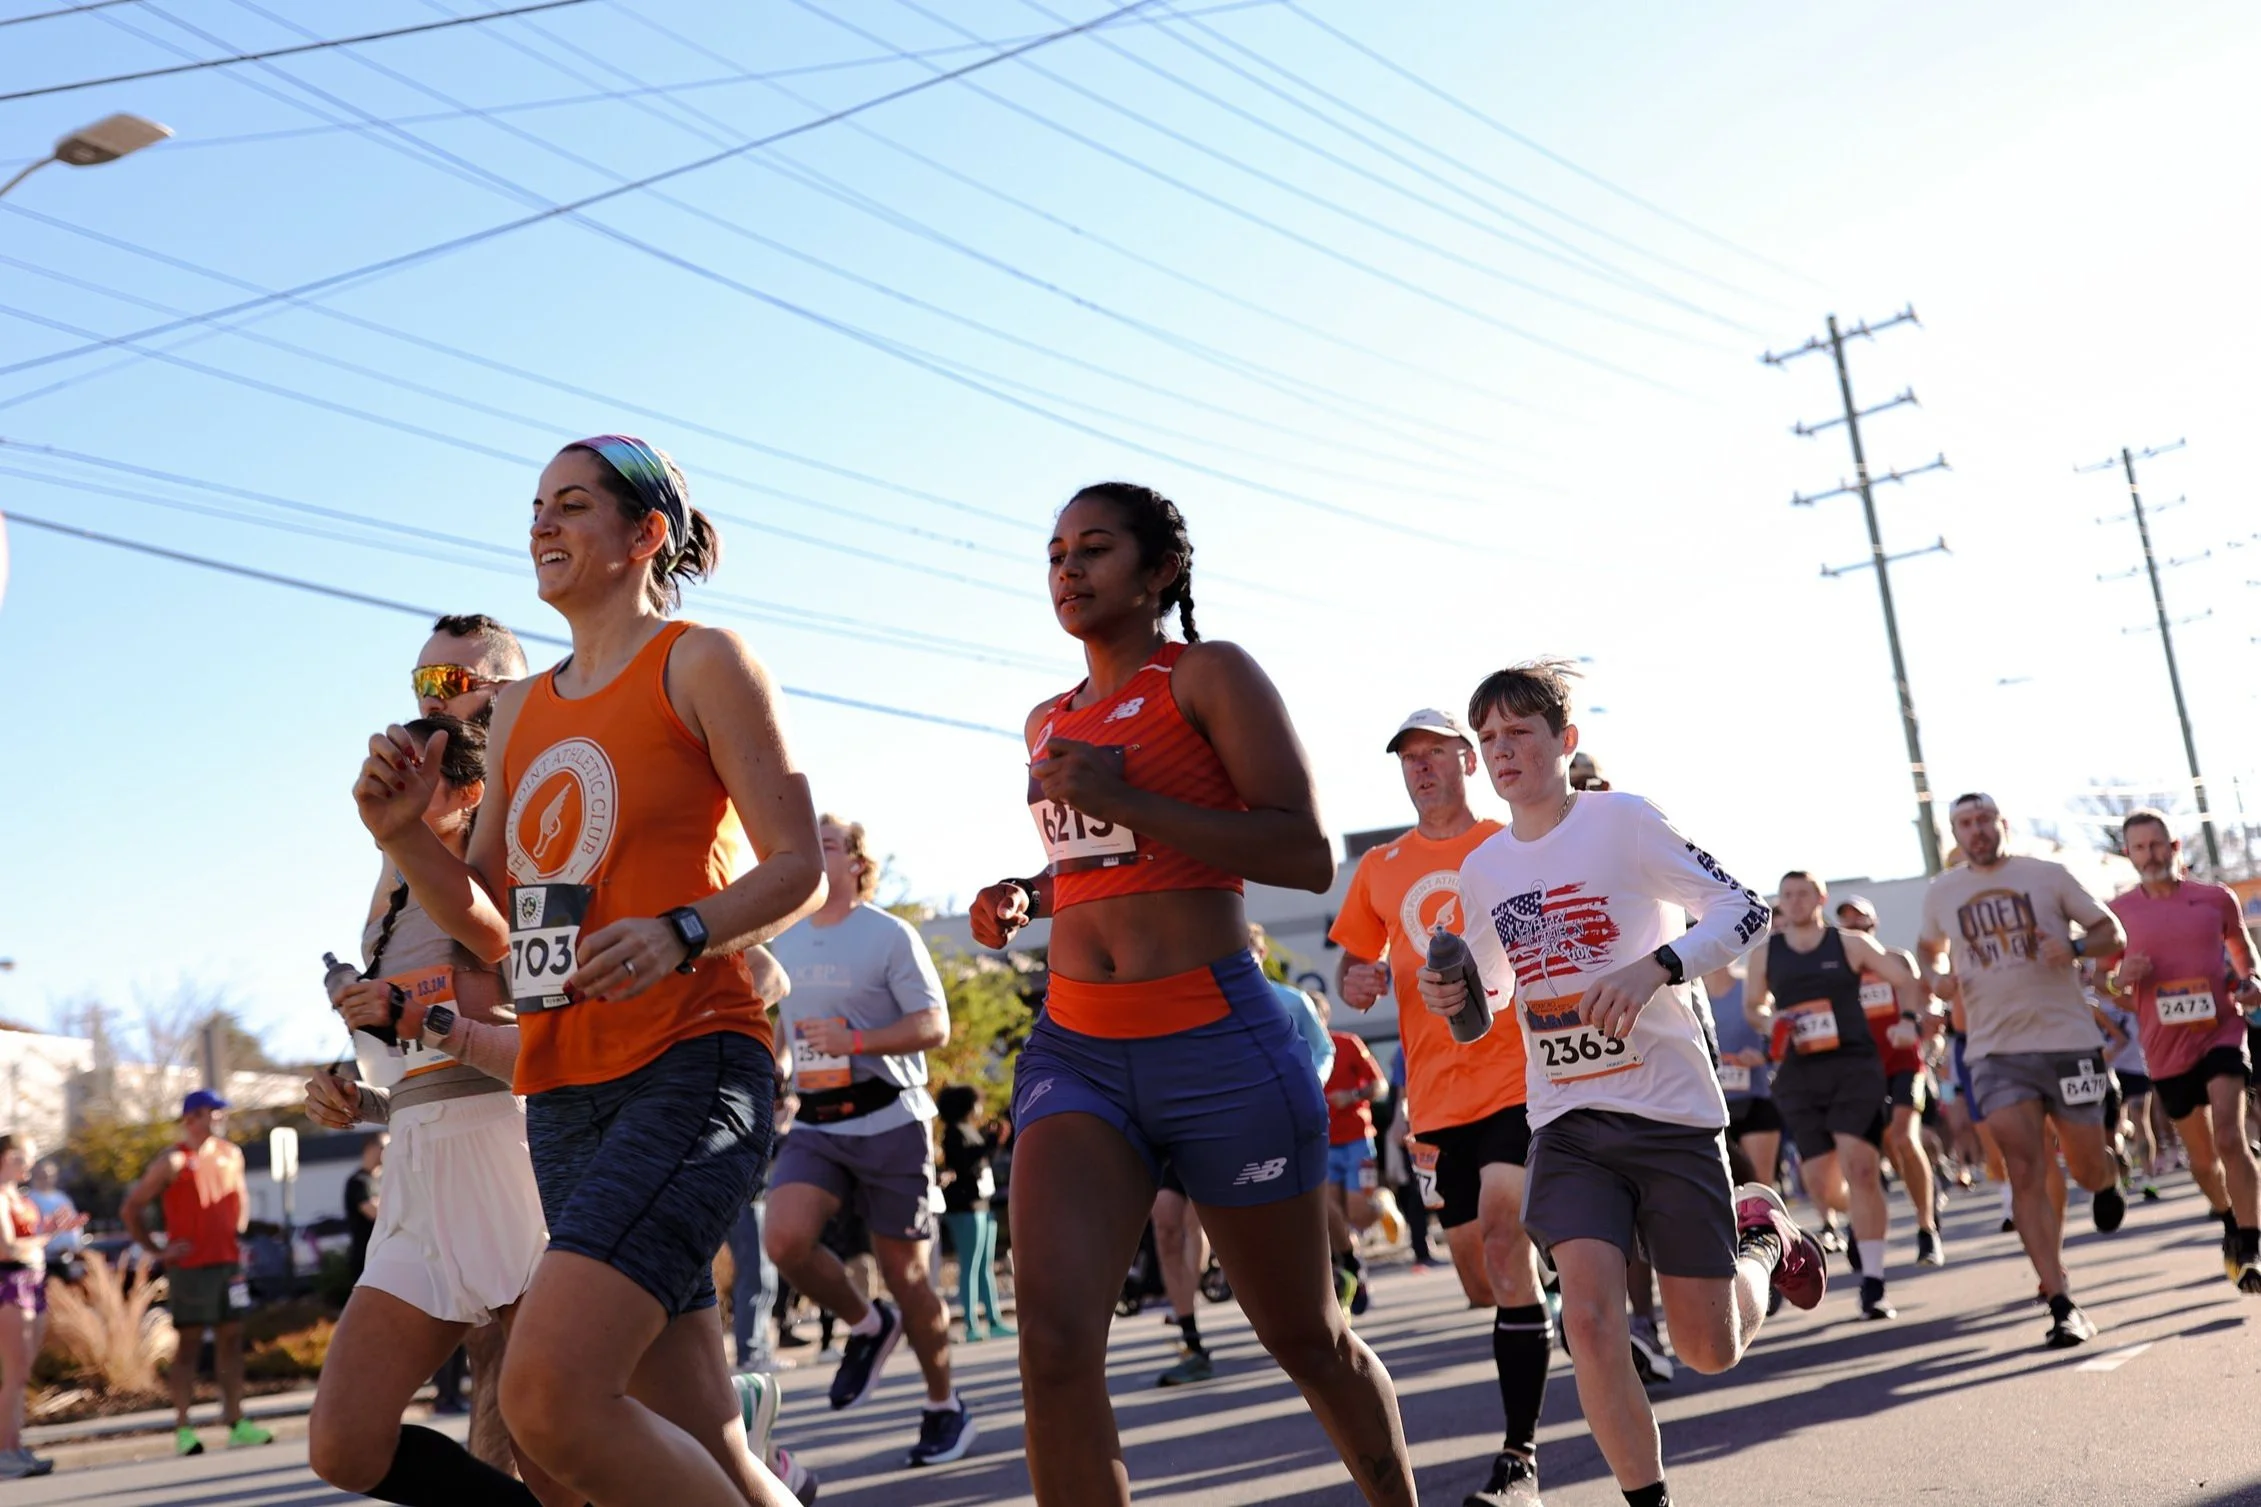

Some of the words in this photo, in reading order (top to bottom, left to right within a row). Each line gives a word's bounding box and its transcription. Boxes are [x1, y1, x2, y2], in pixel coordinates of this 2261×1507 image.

[552, 746, 606, 796] ATHLETIC
[581, 798, 607, 856] CLUB
[1508, 909, 1567, 942] MAYBERRY
[1570, 946, 1594, 960] 10K
[2161, 999, 2211, 1018] 2473
